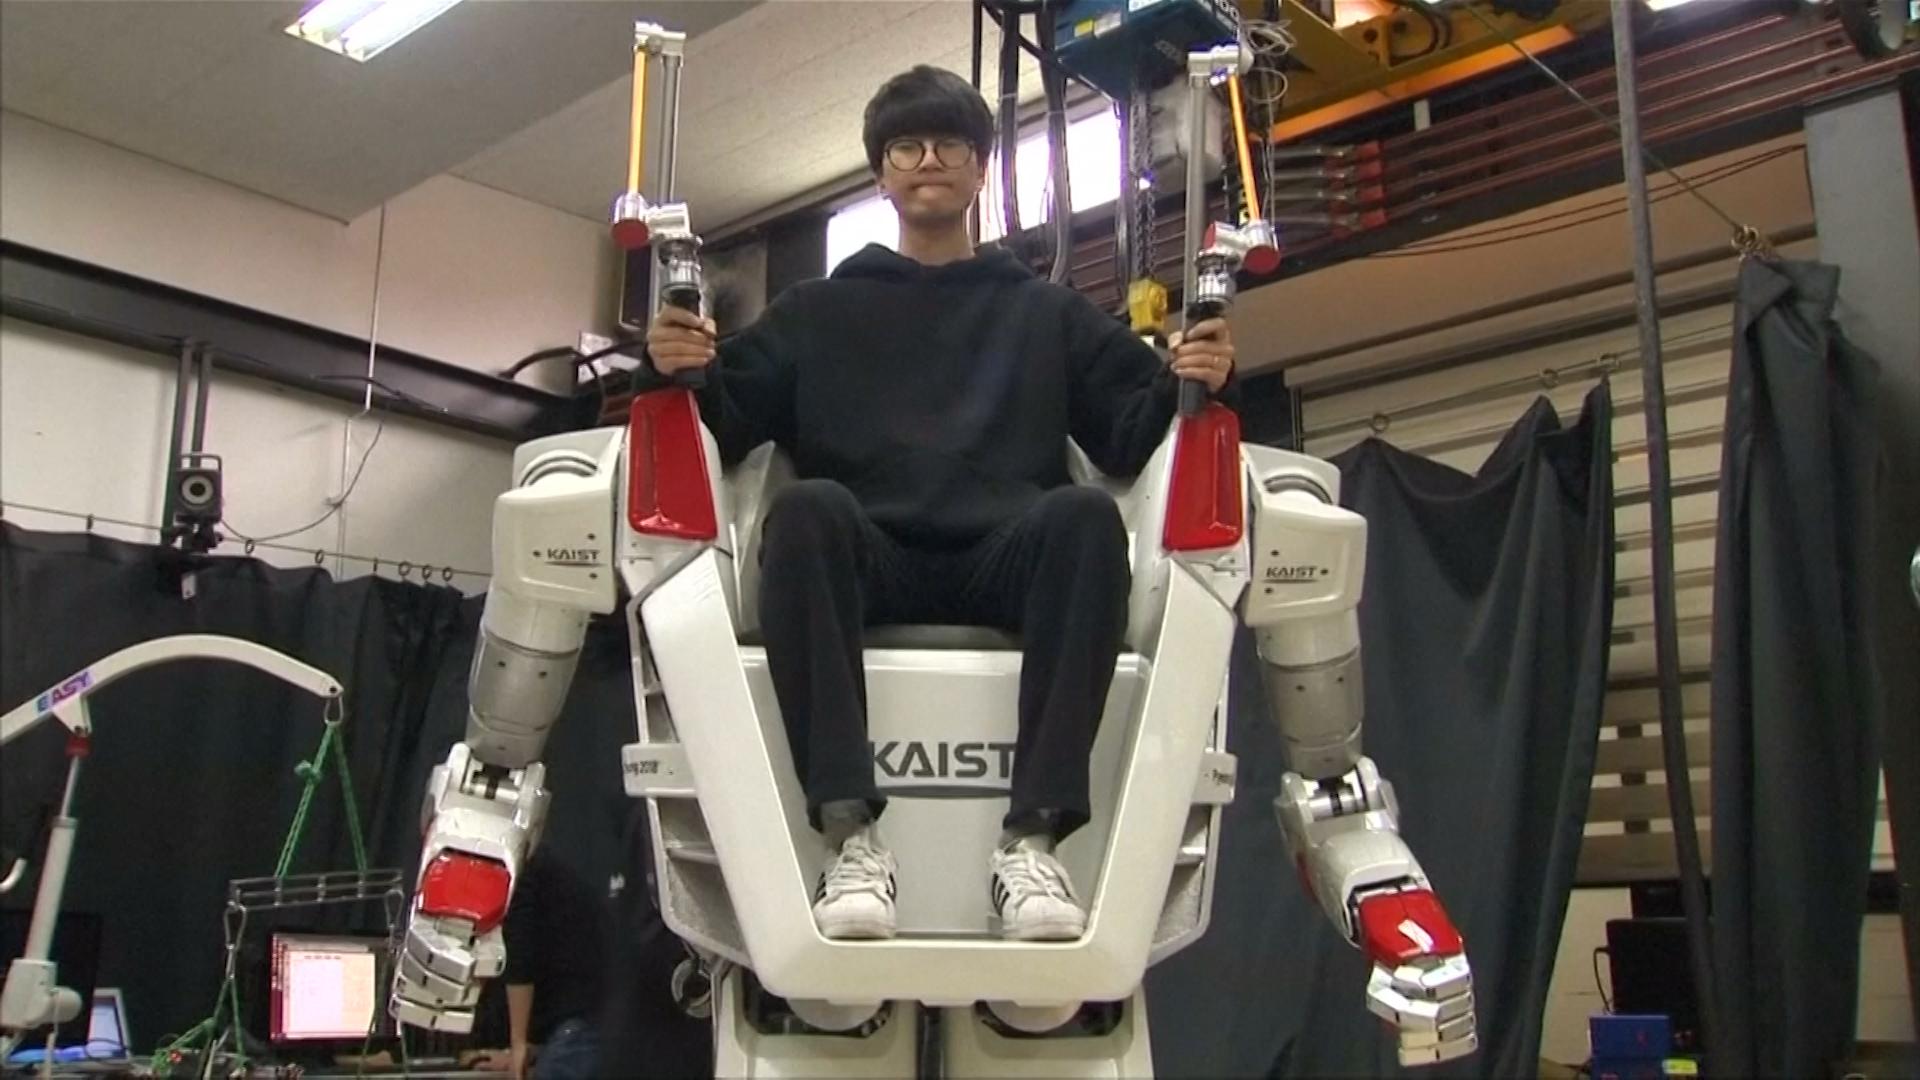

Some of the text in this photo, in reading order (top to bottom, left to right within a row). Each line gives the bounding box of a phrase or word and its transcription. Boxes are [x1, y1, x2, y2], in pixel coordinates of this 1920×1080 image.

[547, 549, 600, 561] KAIST
[1266, 566, 1317, 578] KAIST
[37, 671, 90, 713] EASY
[871, 741, 1016, 778] KAIST
